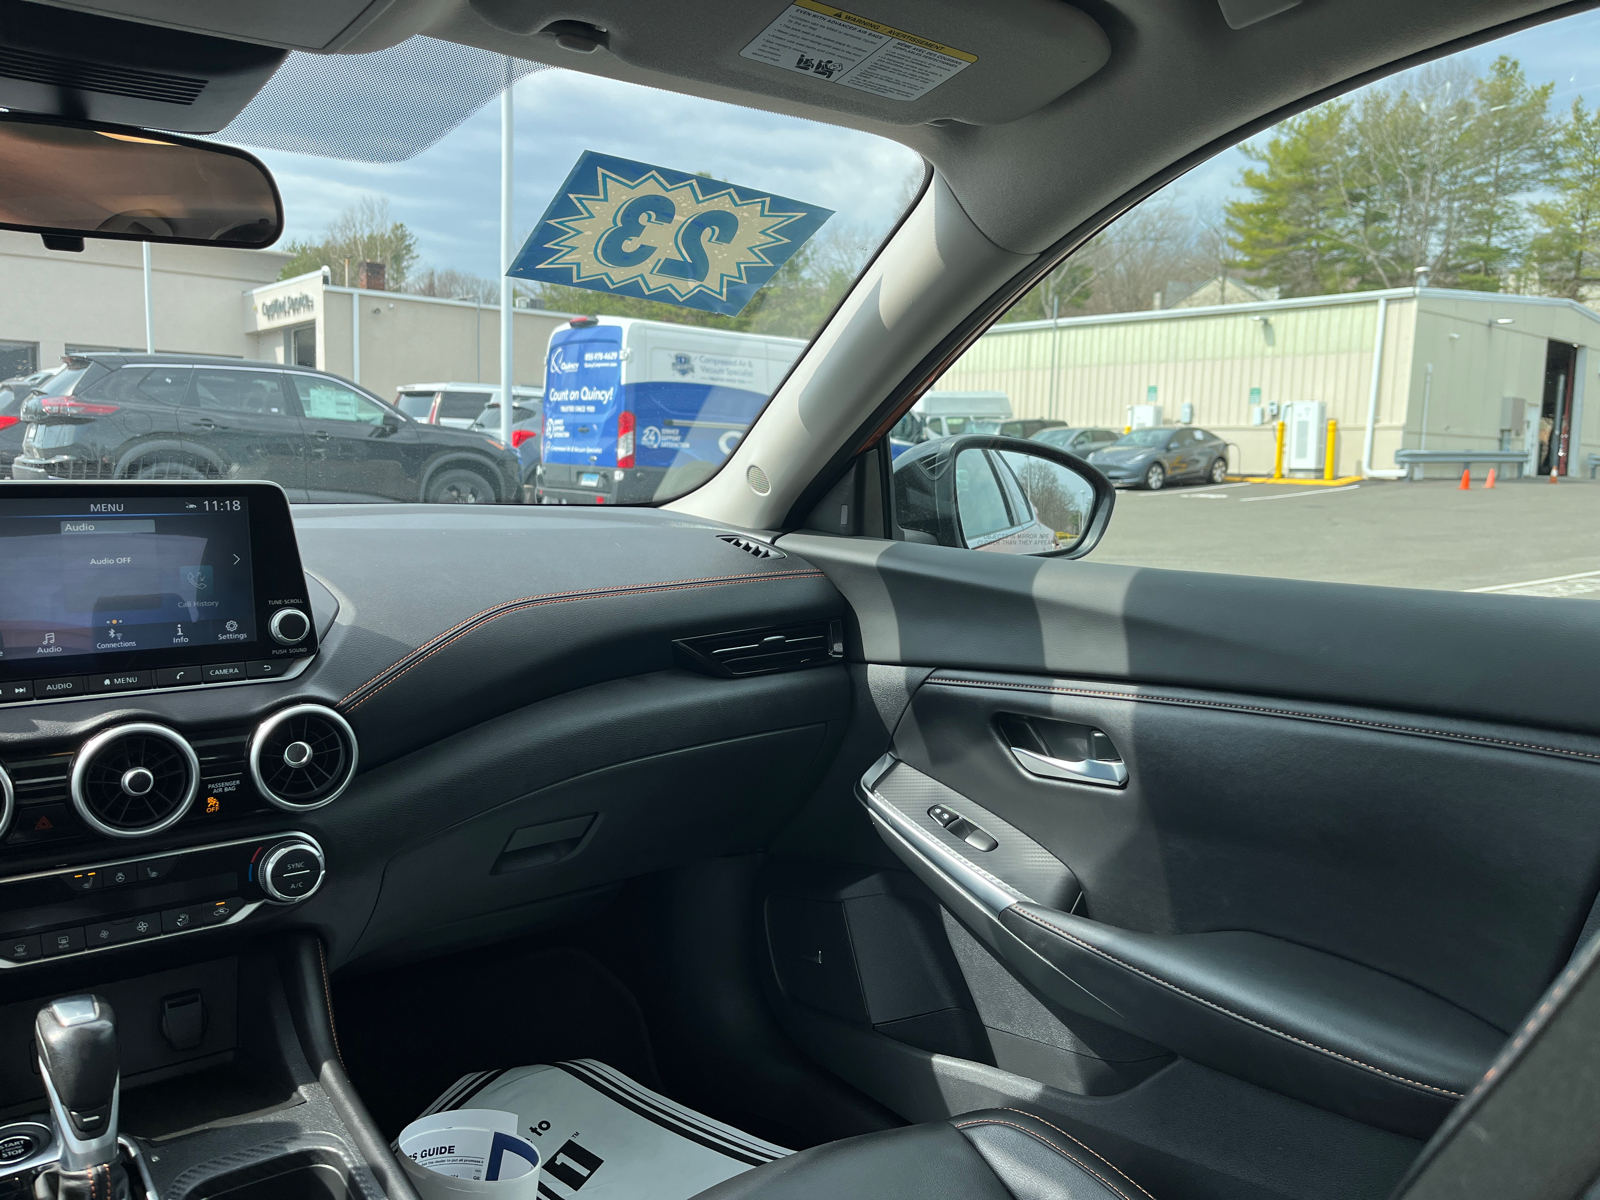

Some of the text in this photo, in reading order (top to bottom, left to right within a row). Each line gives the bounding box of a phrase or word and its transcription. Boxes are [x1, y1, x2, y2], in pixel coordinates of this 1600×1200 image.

[826, 19, 857, 31] ADVANCED
[844, 14, 880, 30] WARNING
[887, 28, 945, 51] AVERTISSEMENT
[549, 386, 614, 405] Count on Quincy!
[90, 503, 124, 512] MENU
[203, 500, 241, 511] 11:18
[64, 523, 95, 532] Audio
[90, 556, 132, 565] Audio OFF
[177, 599, 219, 609] Call History
[218, 632, 248, 642] Settings
[36, 645, 63, 654] Audio
[96, 640, 137, 651] Connections
[209, 668, 240, 677] CAMERA
[114, 677, 138, 686] MENU
[46, 682, 73, 692] AUDIO
[207, 780, 240, 789] PASSENGER
[224, 785, 236, 793] BAG
[287, 862, 305, 870] SYNC
[290, 881, 303, 890] A/C
[528, 1120, 551, 1137] to
[0, 1140, 24, 1149] START
[2, 1149, 24, 1158] STOP
[420, 1145, 456, 1159] GUIDE
